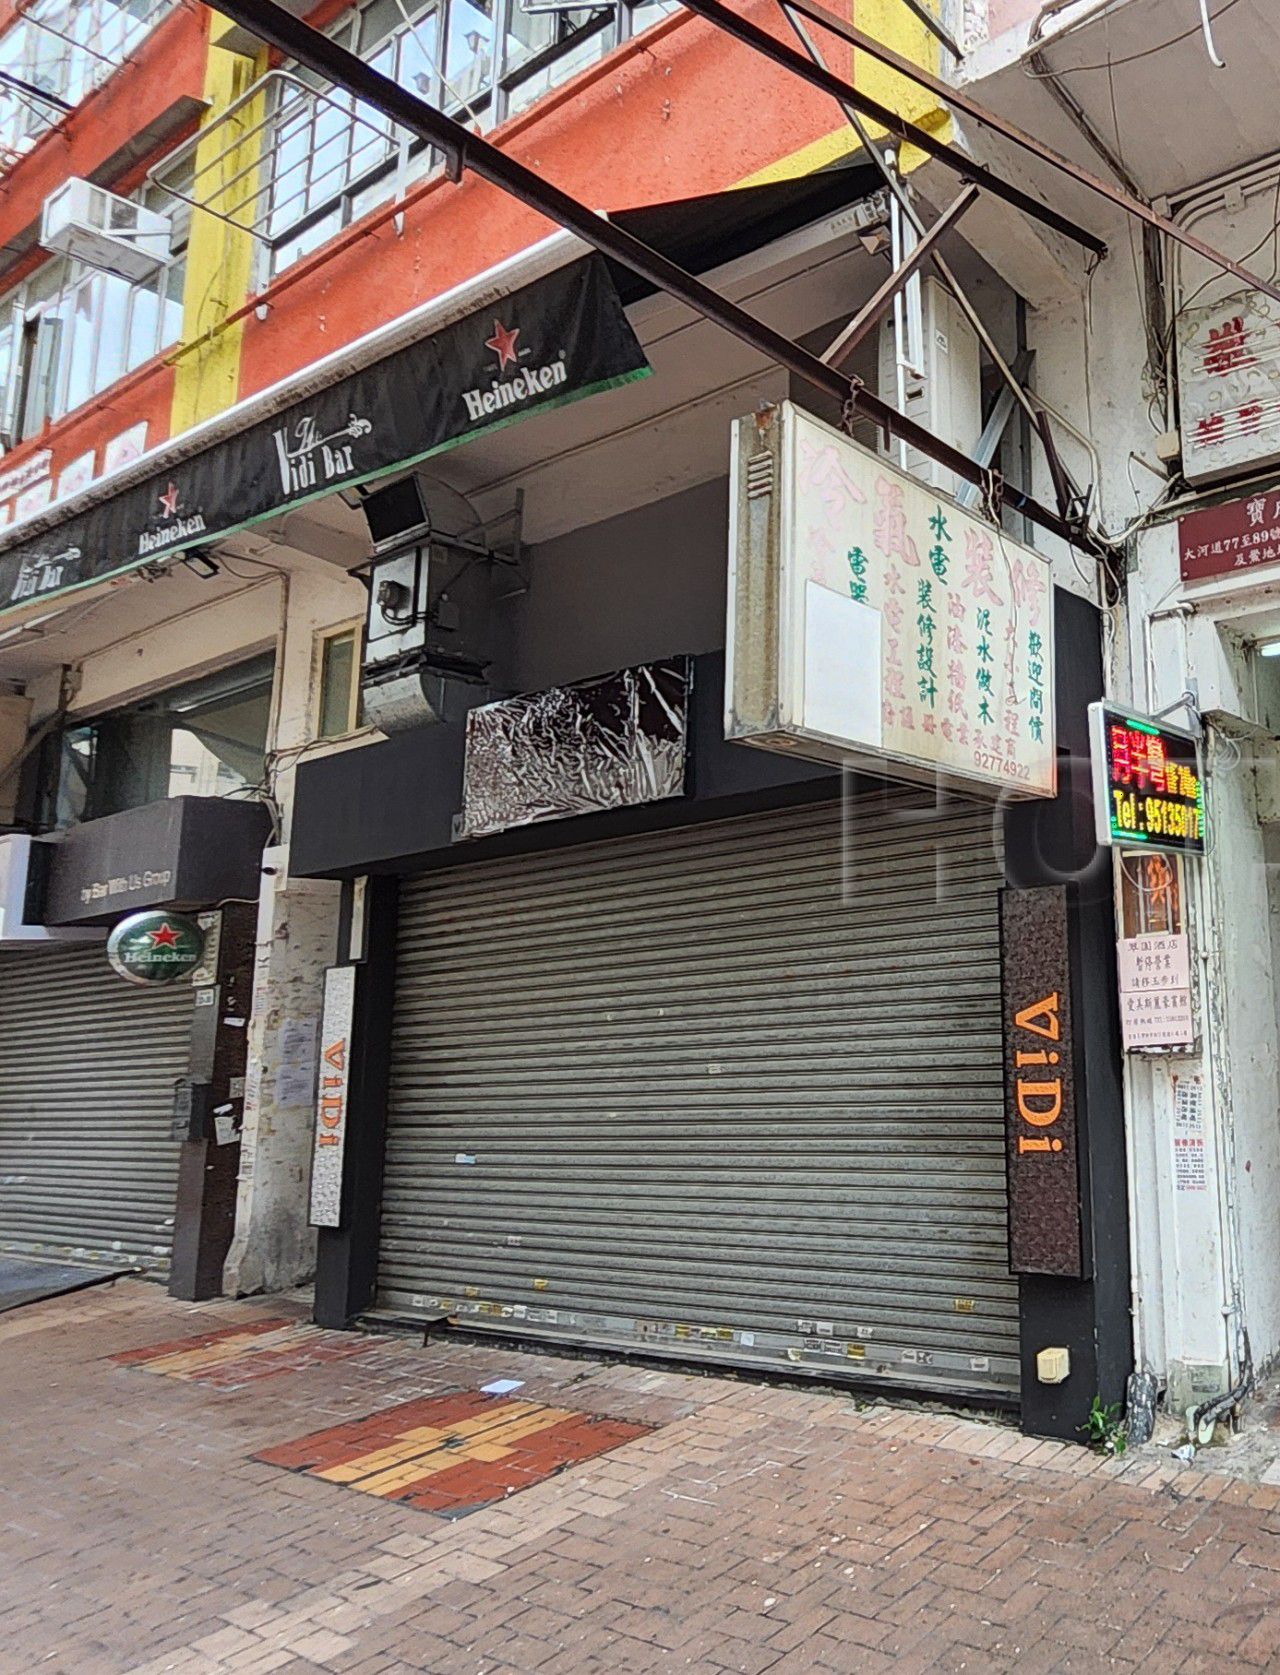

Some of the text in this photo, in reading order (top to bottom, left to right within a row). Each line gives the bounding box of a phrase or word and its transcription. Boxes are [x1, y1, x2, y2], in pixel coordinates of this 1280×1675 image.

[462, 360, 568, 421] Heineken
[273, 427, 354, 495] Vidi Bar
[138, 514, 206, 554] Heineken
[928, 505, 953, 585] 水電
[916, 578, 939, 710] 裝修設計
[973, 750, 1031, 781] 92774922
[123, 951, 198, 963] Heineken
[317, 1038, 346, 1148] ViDi
[1014, 991, 1064, 1155] ViDi
